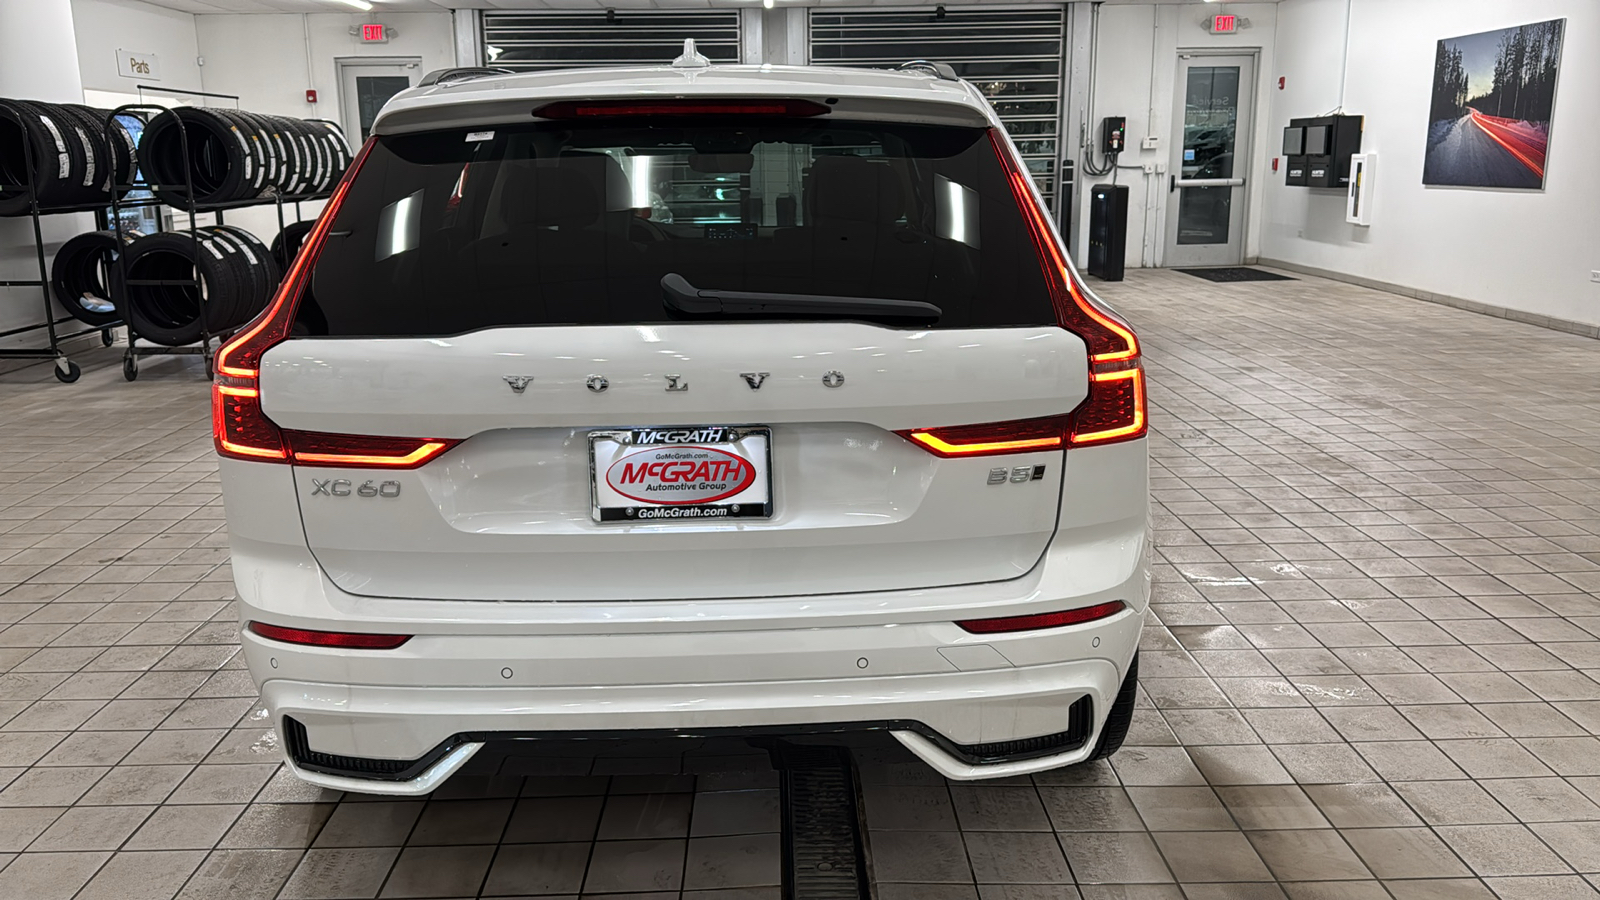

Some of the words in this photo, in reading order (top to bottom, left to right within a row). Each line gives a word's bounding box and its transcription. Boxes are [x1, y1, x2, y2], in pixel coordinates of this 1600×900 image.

[1215, 15, 1235, 31] EXIT
[363, 24, 383, 40] EXIT
[130, 57, 150, 74] Parts
[503, 369, 845, 394] VOLVO
[645, 482, 696, 492] Automotive
[698, 482, 727, 492] Group
[638, 507, 727, 519] GoMcGrath.com
